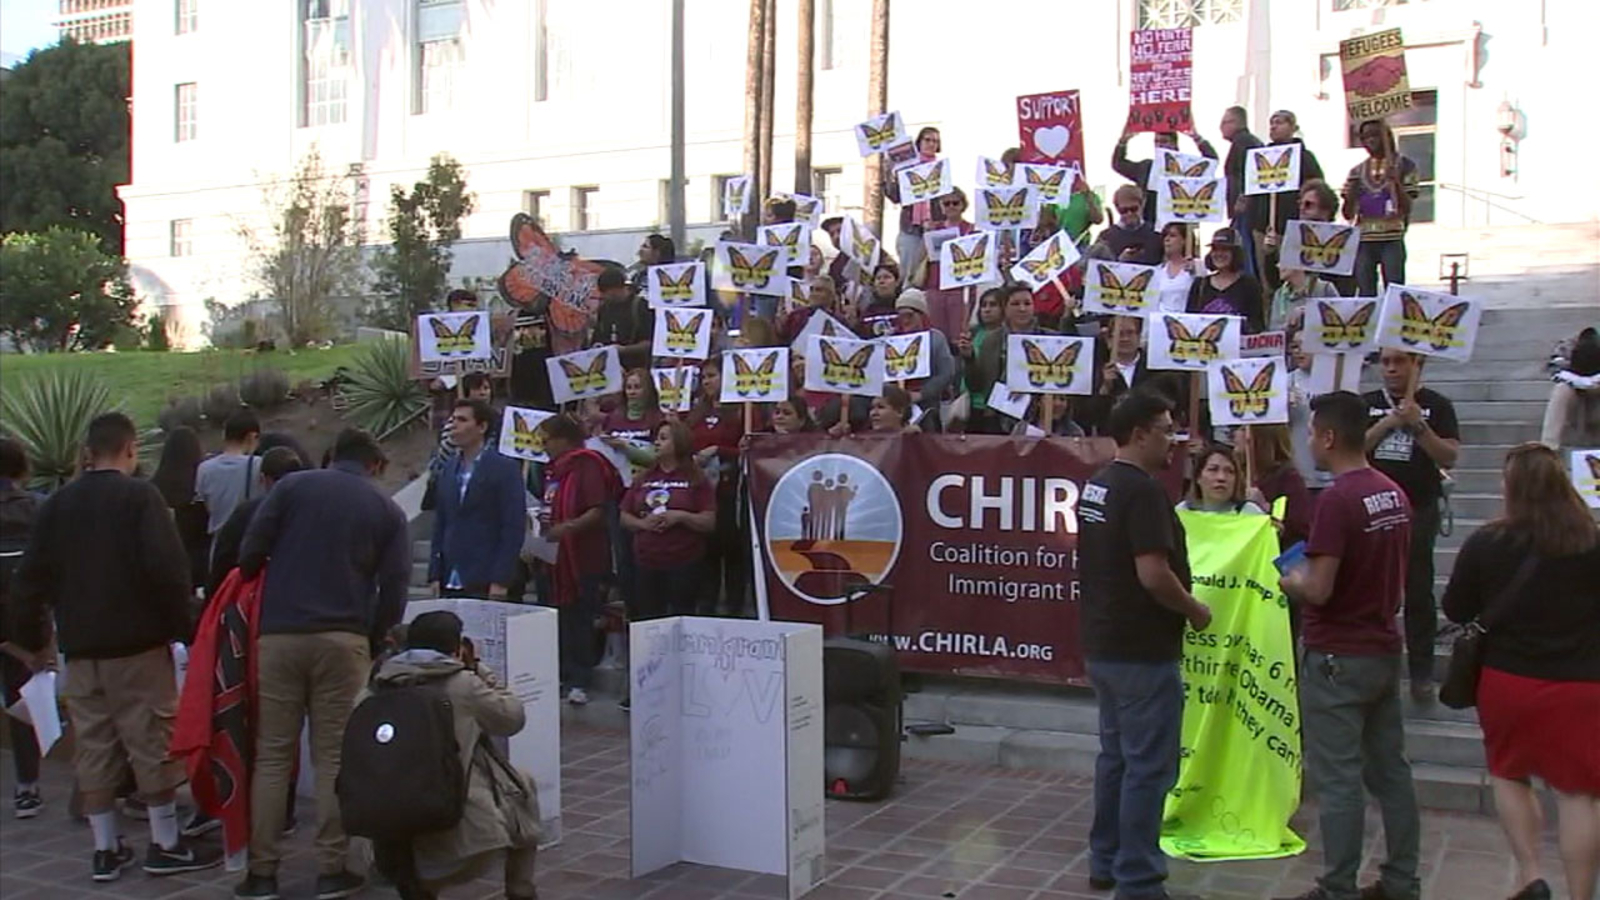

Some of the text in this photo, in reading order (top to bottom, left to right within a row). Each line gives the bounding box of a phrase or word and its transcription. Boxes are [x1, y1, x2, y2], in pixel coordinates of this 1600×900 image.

[1134, 31, 1154, 45] NO
[1340, 32, 1403, 56] REFUGEES
[1020, 93, 1080, 120] SUPPORT
[1130, 88, 1191, 105] HERE
[1348, 94, 1411, 119] WELCOME
[930, 541, 1029, 566] Coalition
[1036, 546, 1066, 569] for
[949, 573, 1065, 602] Immigrant
[1268, 661, 1285, 680] 6
[1239, 669, 1296, 728] Obama
